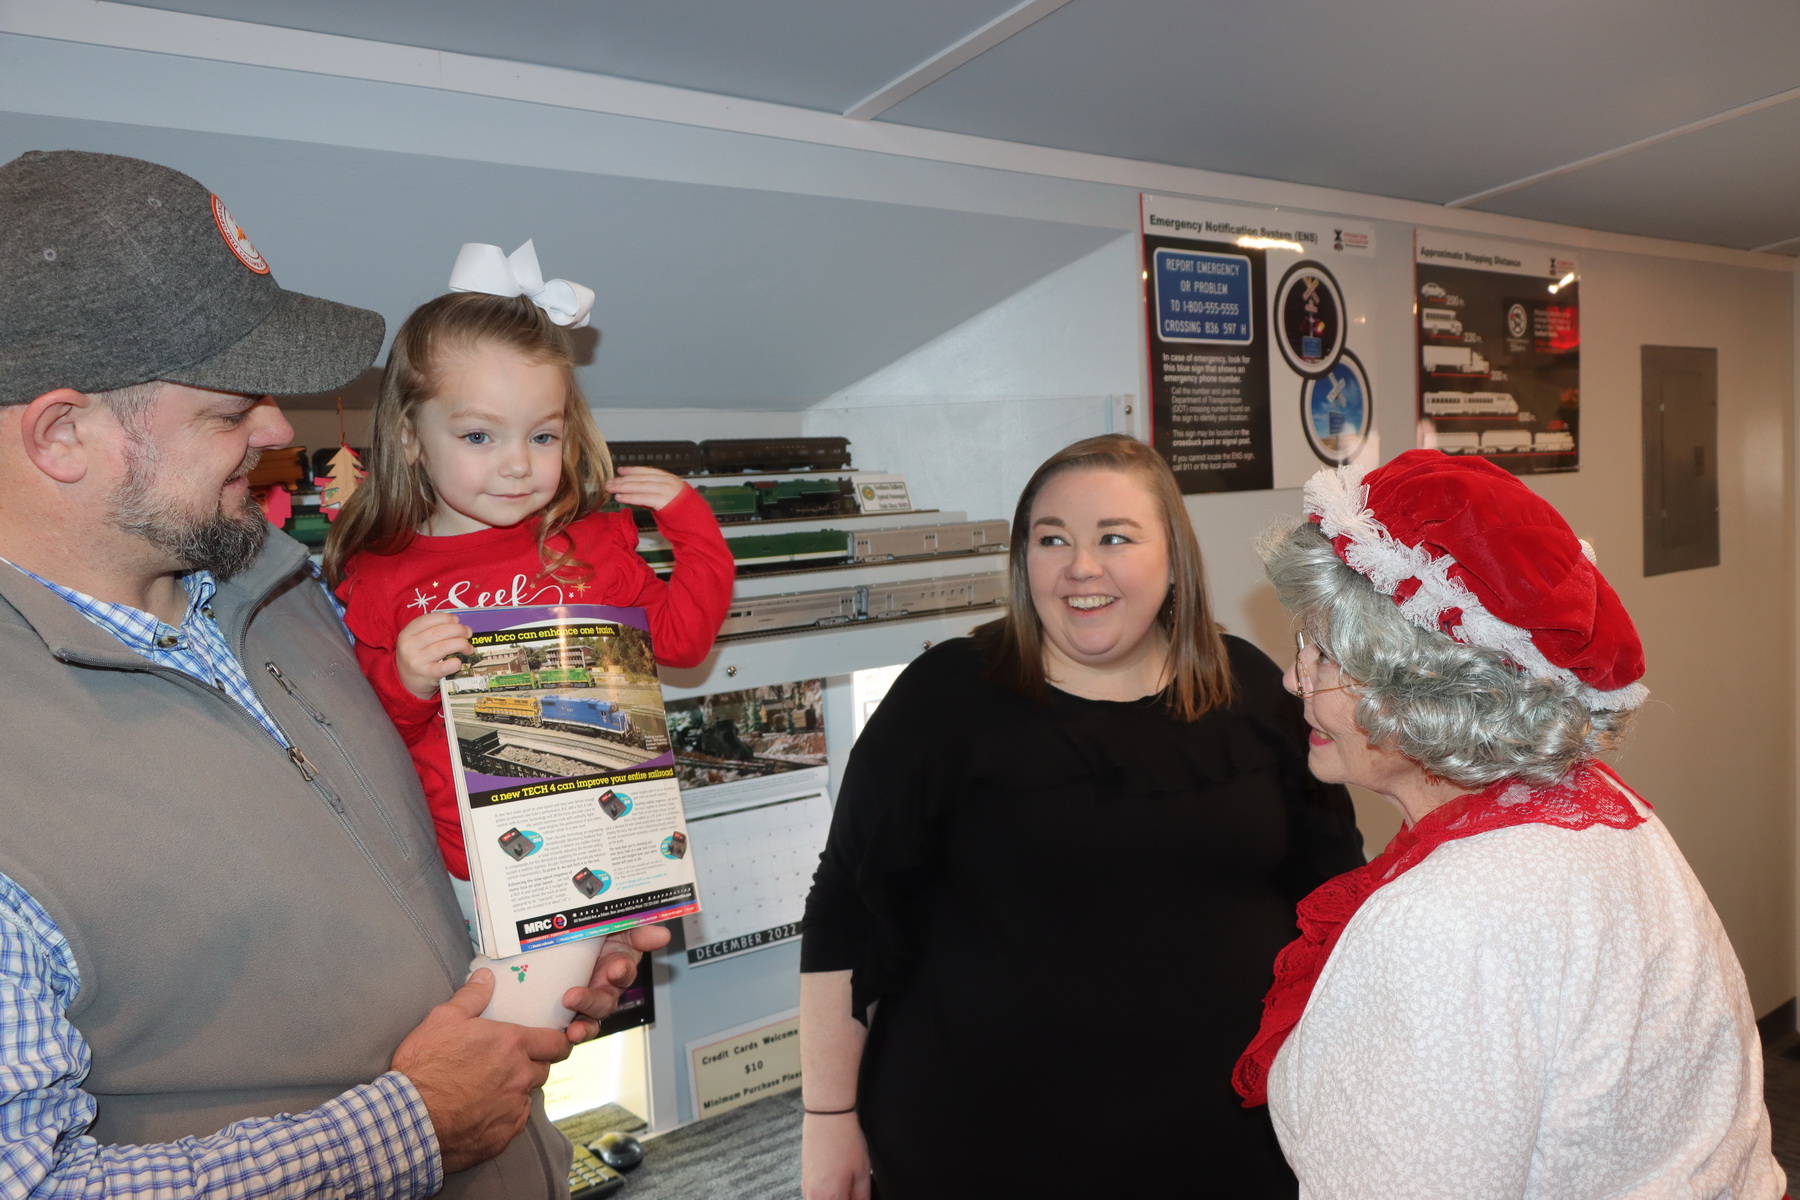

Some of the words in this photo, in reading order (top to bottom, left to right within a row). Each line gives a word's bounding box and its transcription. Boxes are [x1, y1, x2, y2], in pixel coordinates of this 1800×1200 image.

[1150, 214, 1202, 232] Emergency
[1206, 221, 1257, 236] Notification
[1261, 227, 1292, 239] System
[1295, 231, 1318, 245] (ENS)
[1421, 247, 1463, 261] Approximate
[1465, 251, 1493, 266] Stopping
[1494, 256, 1521, 267] Distance
[1166, 259, 1194, 272] REPORT
[1197, 261, 1239, 275] EMERGENCY
[1180, 280, 1191, 292] OR
[1195, 281, 1228, 294] PROBLEM
[1171, 300, 1180, 312] TO
[1183, 300, 1239, 315] 1-800-555-5555
[1165, 319, 1201, 333] CROSSING
[1205, 322, 1219, 334] 836
[1223, 322, 1236, 334] 597
[1241, 324, 1246, 335] H
[1163, 353, 1169, 361] In
[1186, 354, 1193, 362] of
[1228, 355, 1241, 363] look
[1242, 355, 1250, 363] for
[1163, 363, 1175, 371] this
[1177, 364, 1190, 372] blue
[1192, 364, 1204, 374] sign
[1164, 375, 1198, 383] emergency
[1199, 375, 1217, 383] phone
[438, 574, 548, 608] Seek
[472, 635, 493, 645] new
[495, 632, 515, 642] loco
[518, 631, 537, 640] can
[539, 627, 578, 638] enhance
[580, 626, 594, 635] one
[596, 625, 616, 636] train,
[491, 794, 499, 802] a
[500, 790, 521, 801] new
[522, 785, 549, 797] TECH
[549, 783, 555, 793] 4
[557, 780, 575, 791] can
[576, 776, 609, 789] improve
[610, 774, 627, 786] your
[627, 771, 647, 782] entire
[648, 767, 674, 780] railroad
[524, 919, 552, 934] MRC
[696, 933, 762, 960] DECEMBER
[767, 924, 797, 942] 2022
[702, 1050, 729, 1065] Credit
[734, 1041, 758, 1055] Cards
[762, 1029, 798, 1045] Welcome
[744, 1060, 764, 1074] $10
[703, 1091, 741, 1110] Minimum
[743, 1079, 780, 1096] Purchase
